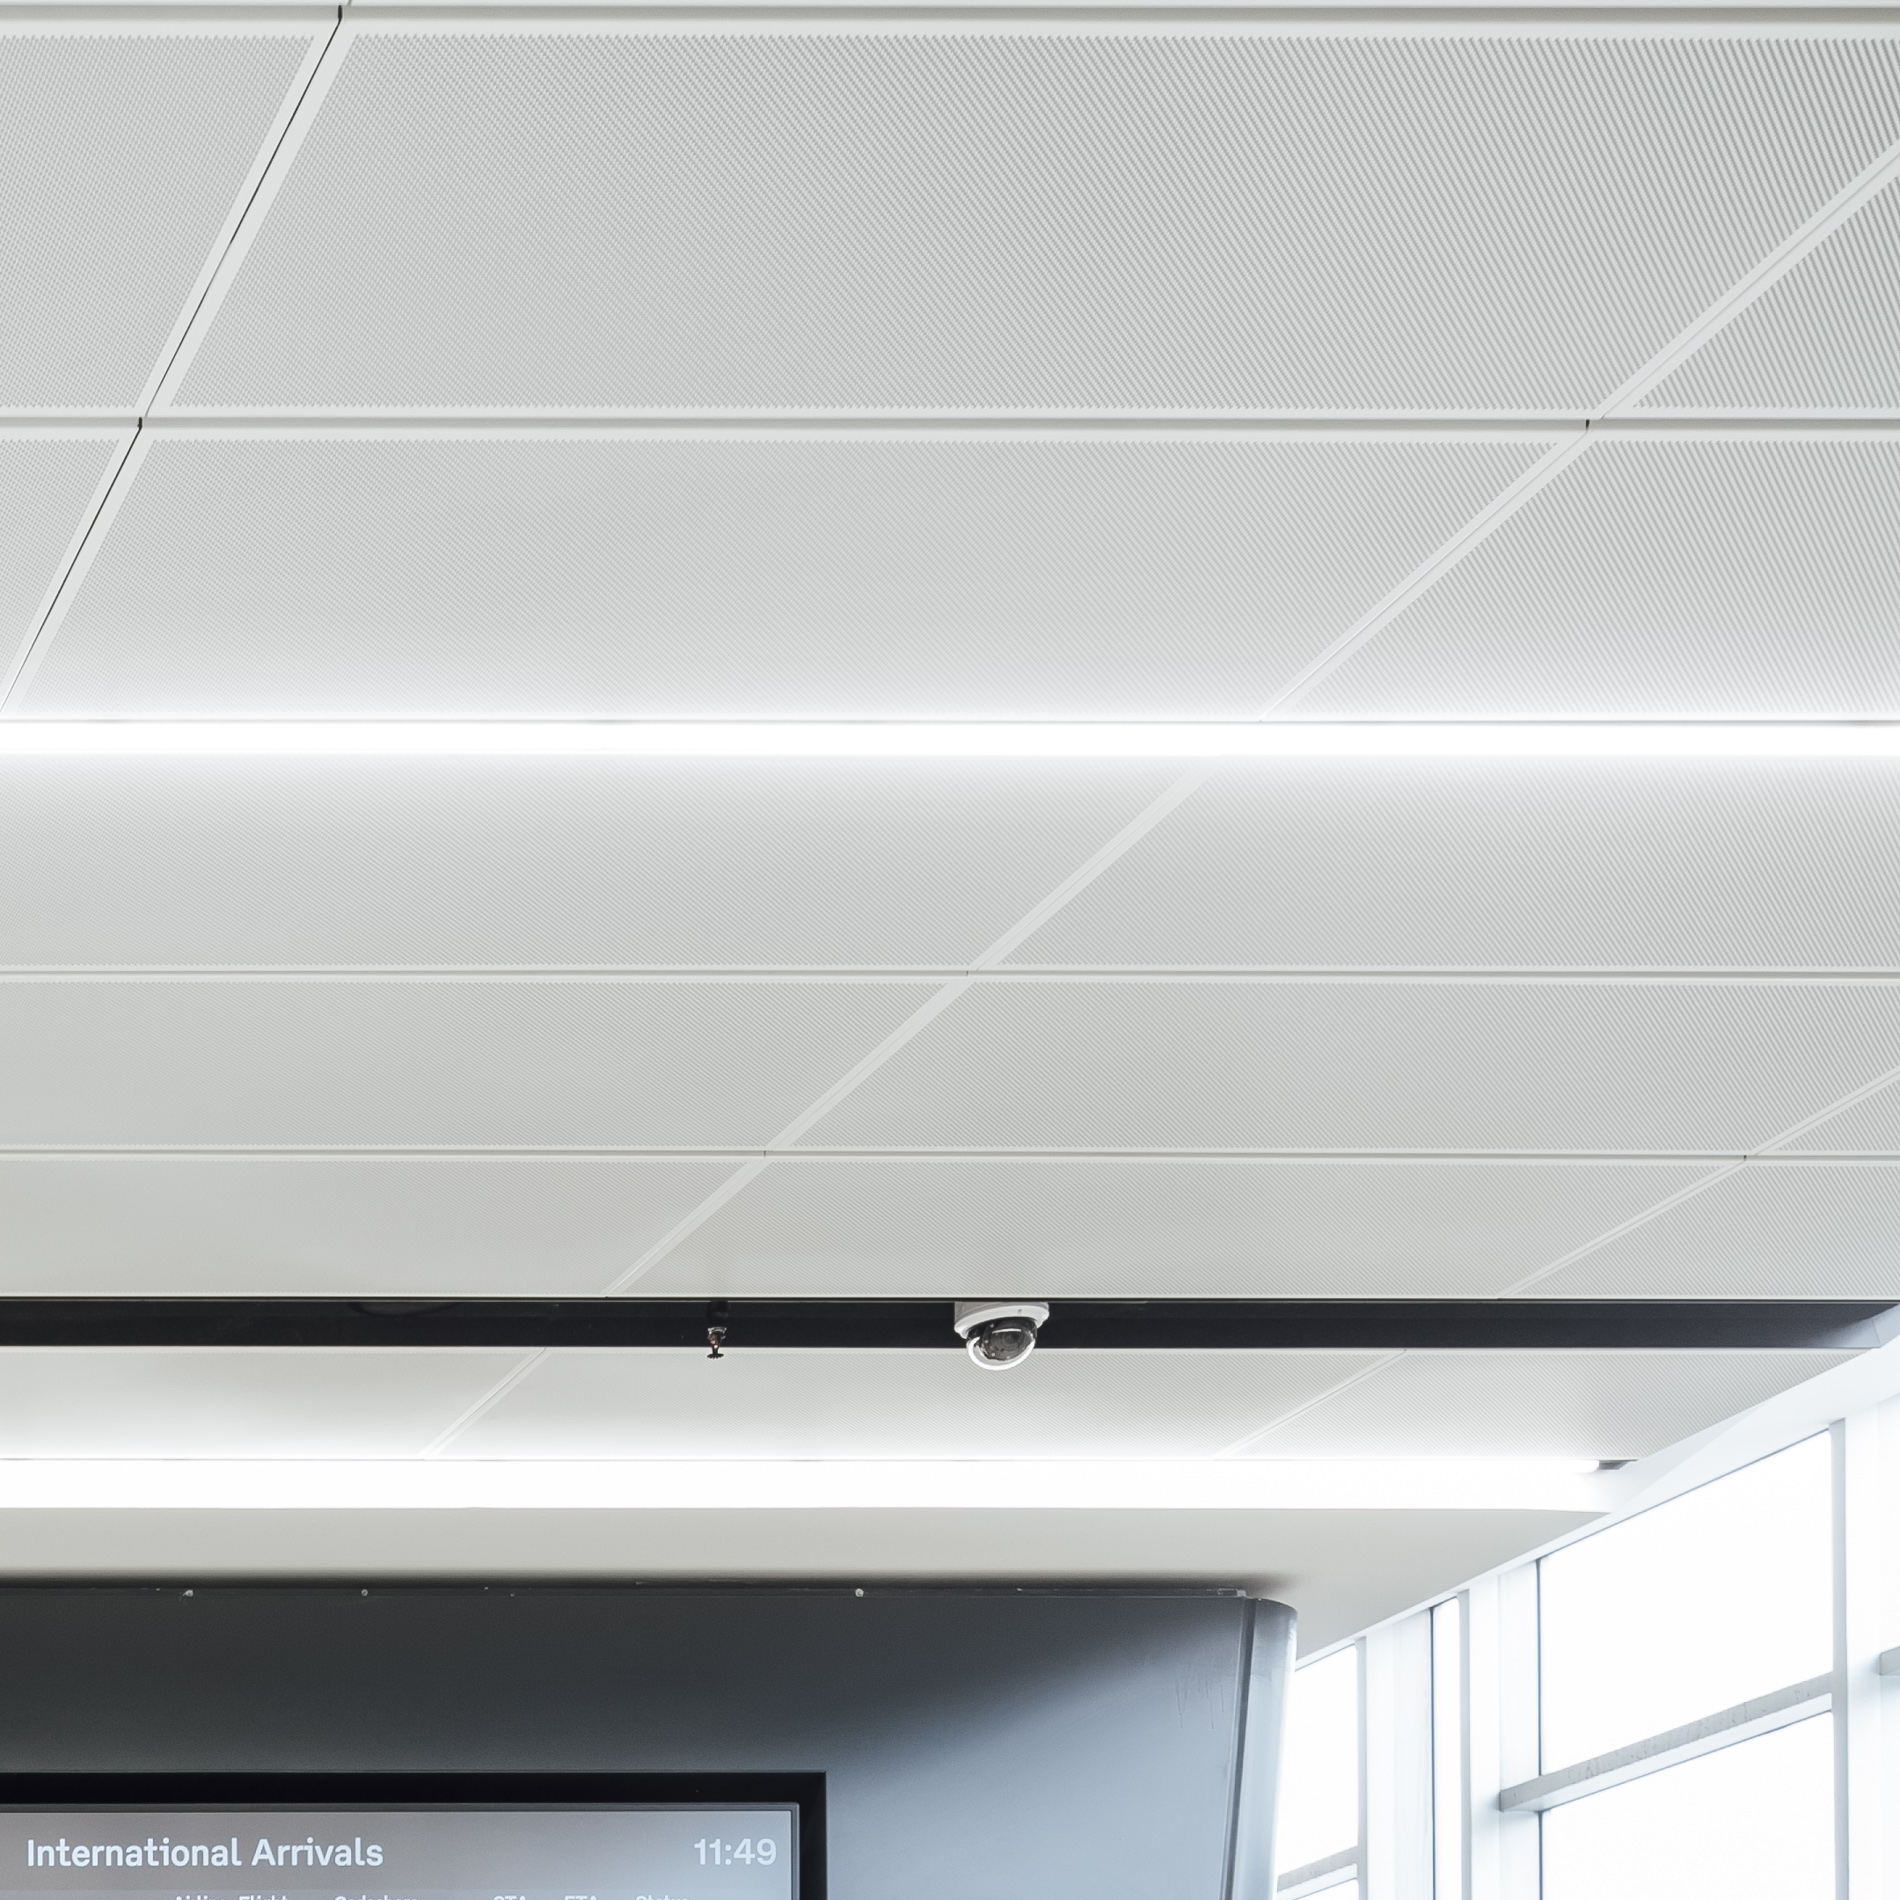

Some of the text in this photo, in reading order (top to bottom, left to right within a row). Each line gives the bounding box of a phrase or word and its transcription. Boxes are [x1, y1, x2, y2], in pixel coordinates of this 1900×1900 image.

[27, 1836, 385, 1867] International Arrivals
[694, 1838, 777, 1866] 11:49
